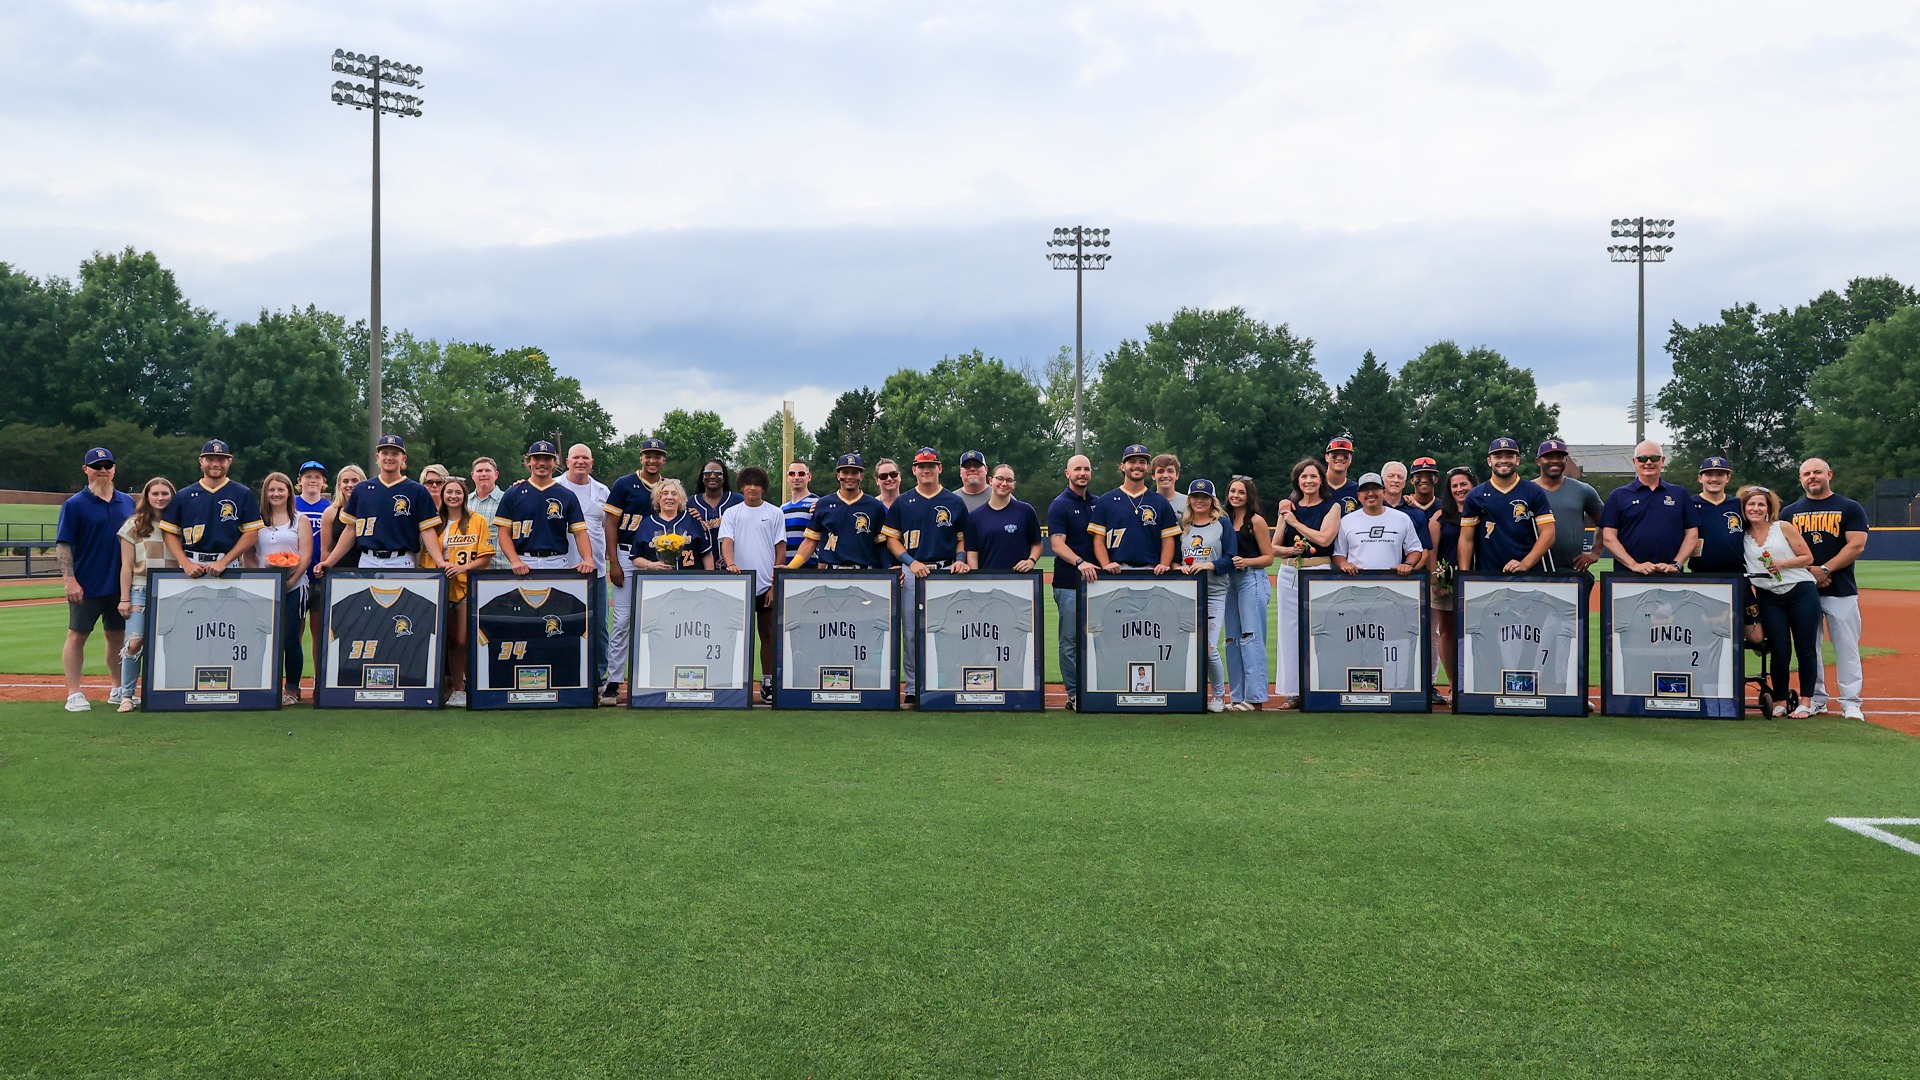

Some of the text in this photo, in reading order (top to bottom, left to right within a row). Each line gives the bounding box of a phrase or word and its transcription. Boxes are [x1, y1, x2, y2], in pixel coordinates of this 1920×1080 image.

[355, 516, 377, 537] 35
[512, 520, 534, 539] 34
[1368, 525, 1386, 539] G
[1484, 520, 1496, 539] 7
[1792, 513, 1843, 538] SPARTANS
[903, 529, 921, 550] 19
[1106, 527, 1127, 549] 17
[456, 550, 478, 566] 35
[1183, 547, 1212, 557] UNCG
[196, 621, 236, 641] UNCG
[675, 620, 711, 640] UNCG
[819, 621, 856, 640] UNCG
[961, 621, 999, 641] UNCG
[1122, 620, 1161, 640] UNCG
[1346, 623, 1385, 643] UNCG
[1501, 624, 1541, 644] UNCG
[1650, 625, 1692, 646] UNCG
[232, 645, 248, 661] 38
[348, 639, 379, 660] 35
[497, 640, 528, 661] 34
[706, 644, 721, 660] 23
[853, 645, 867, 661] 16
[995, 645, 1010, 662] 19
[1157, 644, 1172, 661] 17
[1383, 646, 1398, 662] 10
[1541, 649, 1549, 666] 7
[1691, 650, 1699, 667] 2
